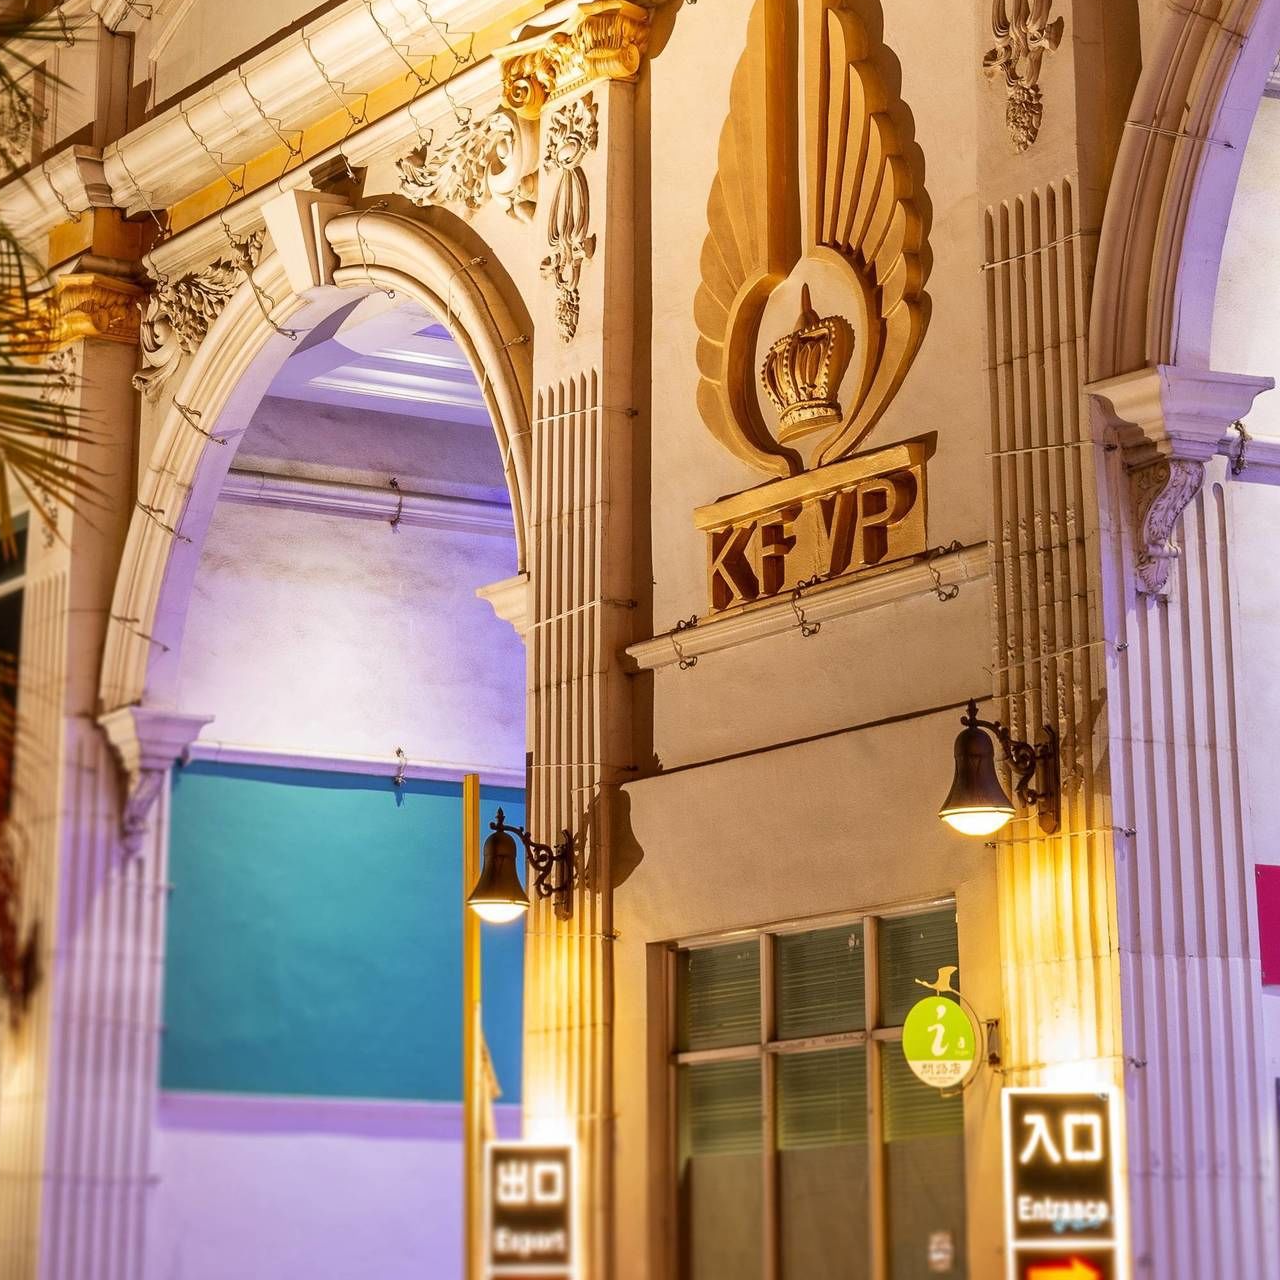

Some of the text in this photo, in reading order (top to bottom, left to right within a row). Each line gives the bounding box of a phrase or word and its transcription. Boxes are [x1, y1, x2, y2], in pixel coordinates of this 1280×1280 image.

[1019, 1113, 1104, 1165] 入口
[497, 1161, 565, 1204] 出口
[1017, 1194, 1109, 1222] Entrance
